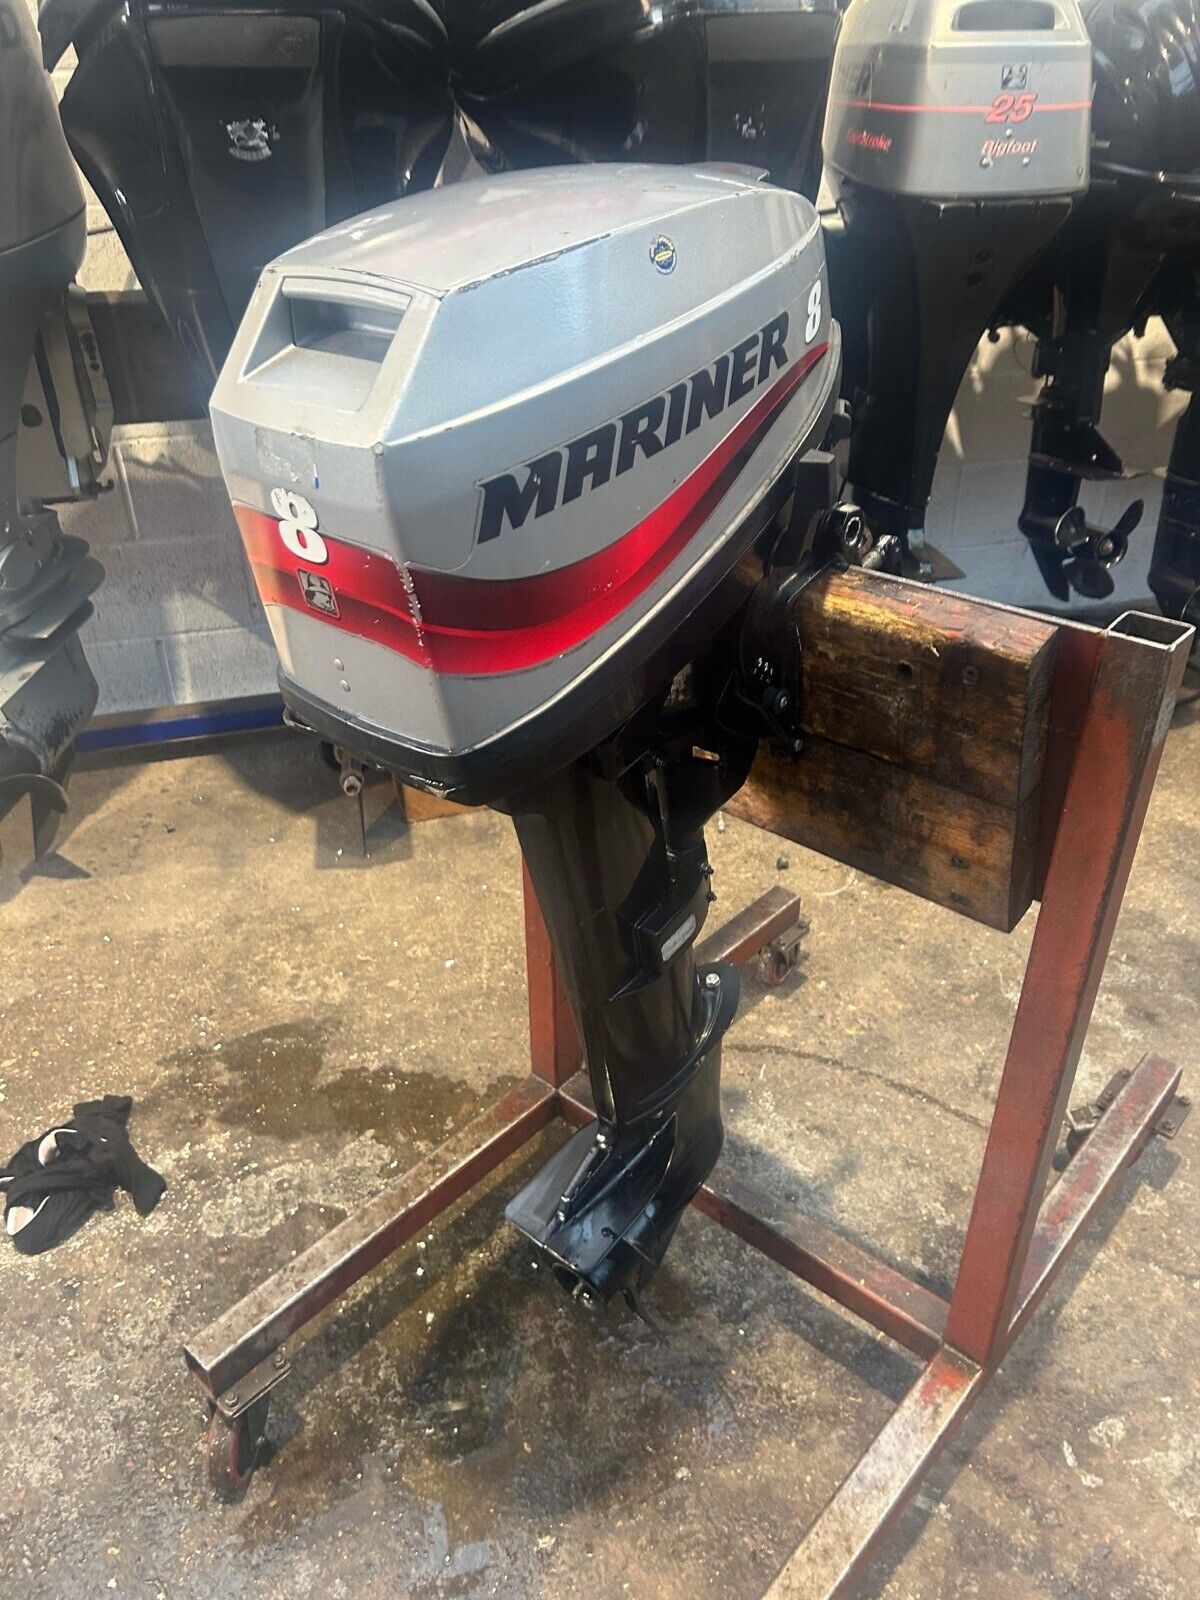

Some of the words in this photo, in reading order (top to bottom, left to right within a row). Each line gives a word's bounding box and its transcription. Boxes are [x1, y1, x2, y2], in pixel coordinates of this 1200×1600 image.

[985, 92, 1037, 123] 25
[805, 279, 822, 344] 8
[477, 311, 789, 545] MARINER
[271, 488, 328, 564] 8
